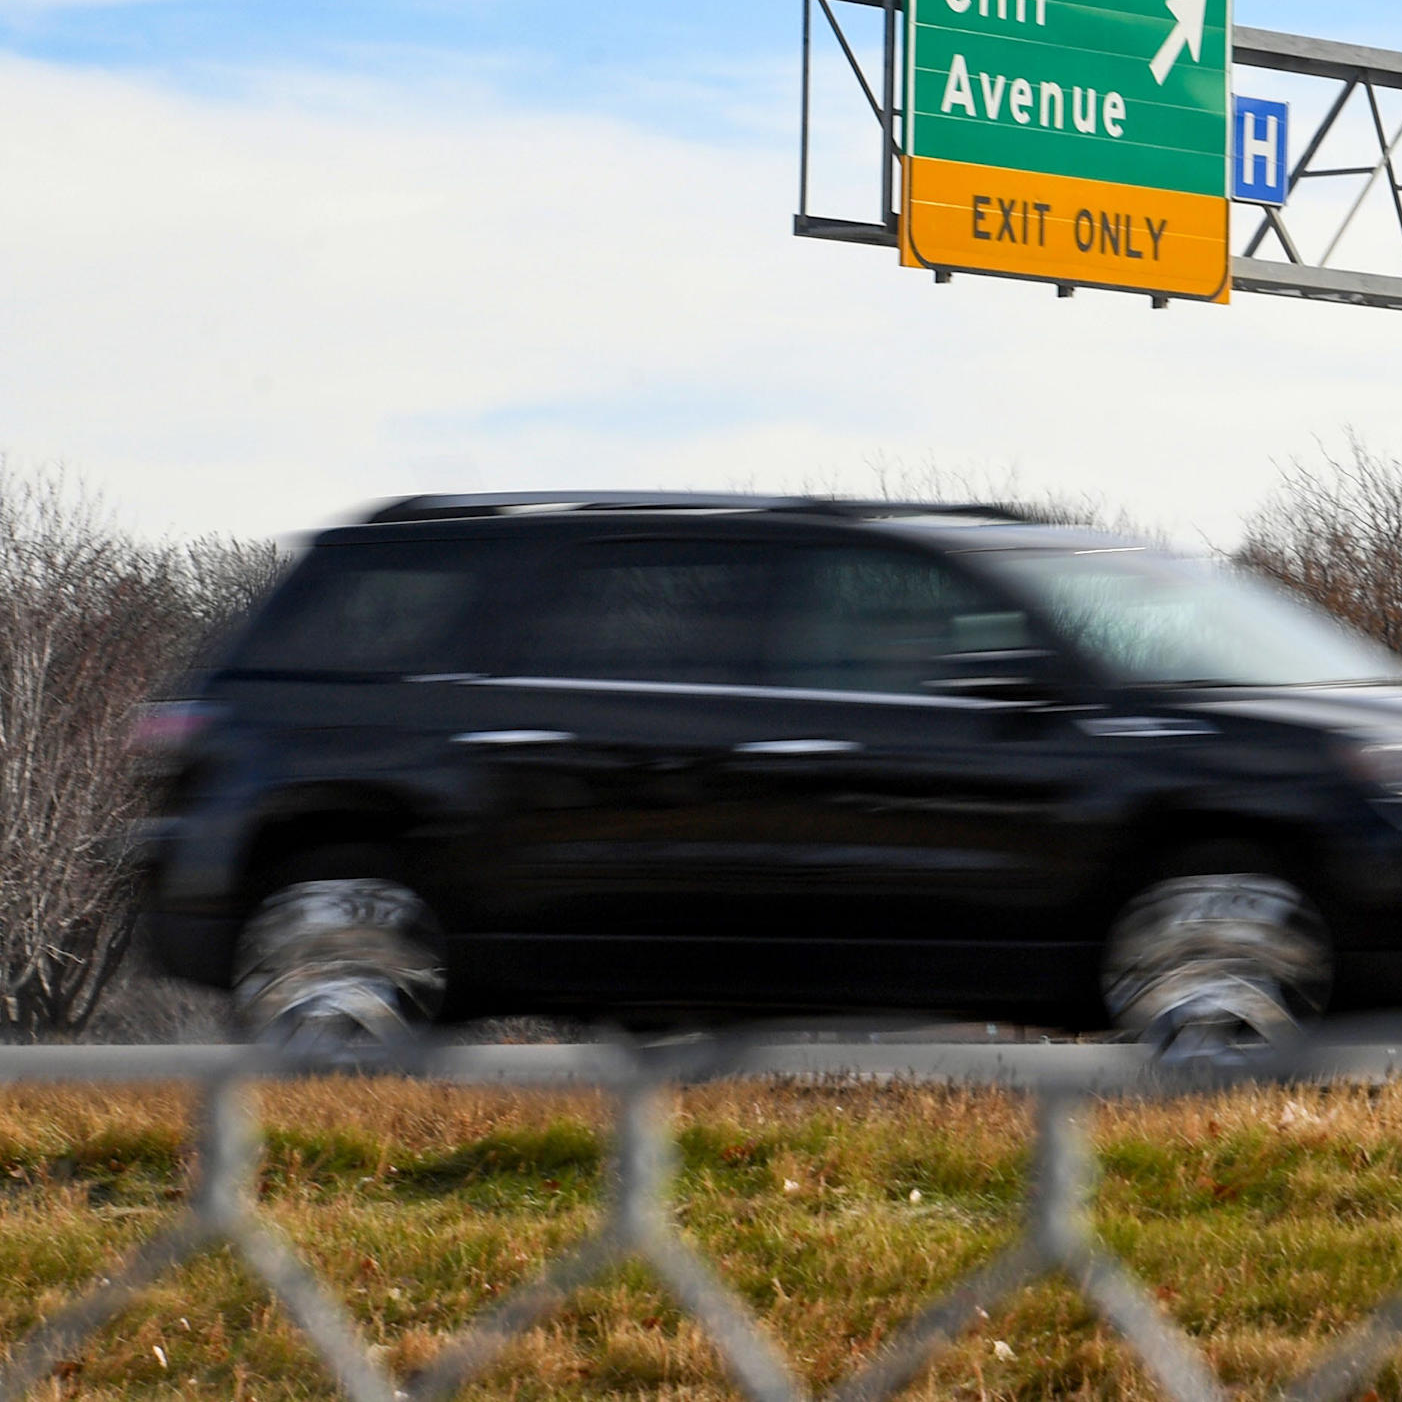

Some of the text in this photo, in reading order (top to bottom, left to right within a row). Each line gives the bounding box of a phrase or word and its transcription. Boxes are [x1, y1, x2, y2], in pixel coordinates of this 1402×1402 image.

[940, 53, 1127, 139] Avenue
[1243, 110, 1279, 189] H
[971, 195, 1168, 262] EXIT ONLY
